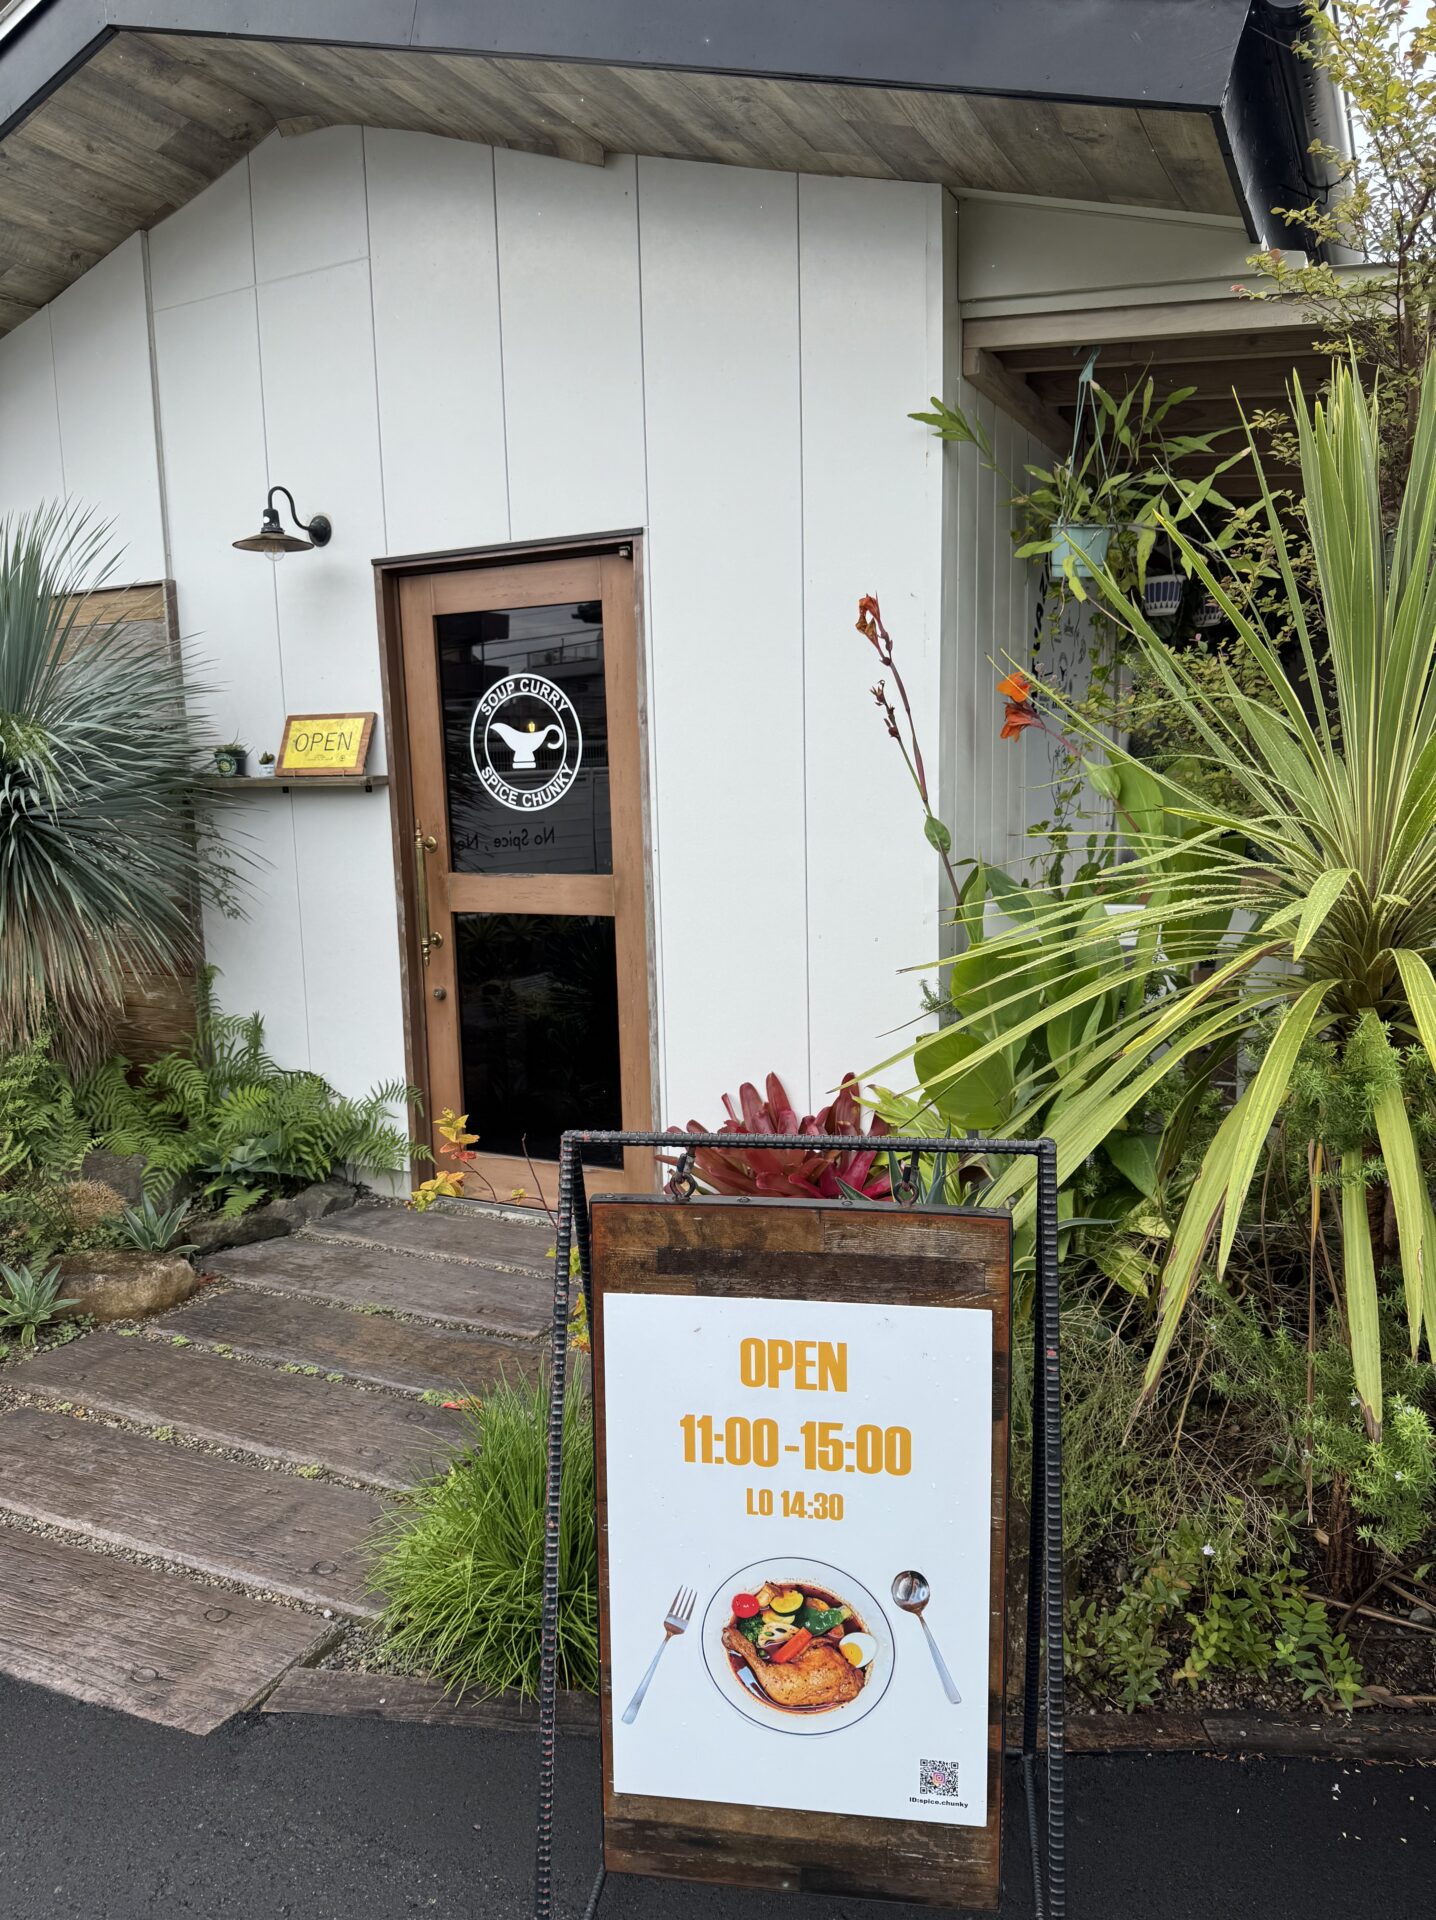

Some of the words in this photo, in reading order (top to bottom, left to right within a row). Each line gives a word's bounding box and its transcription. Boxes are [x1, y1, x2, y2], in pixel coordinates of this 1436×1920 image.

[480, 681, 515, 716] SOUP
[520, 678, 569, 712] CURRY
[294, 731, 353, 753] OPEN
[481, 766, 519, 805] SPICE
[522, 762, 573, 807] CHUNKY
[740, 1337, 848, 1393] OPEN
[746, 1487, 774, 1516] LO
[780, 1490, 844, 1521] 14:30
[909, 1796, 969, 1809] ID:spice.chunky
